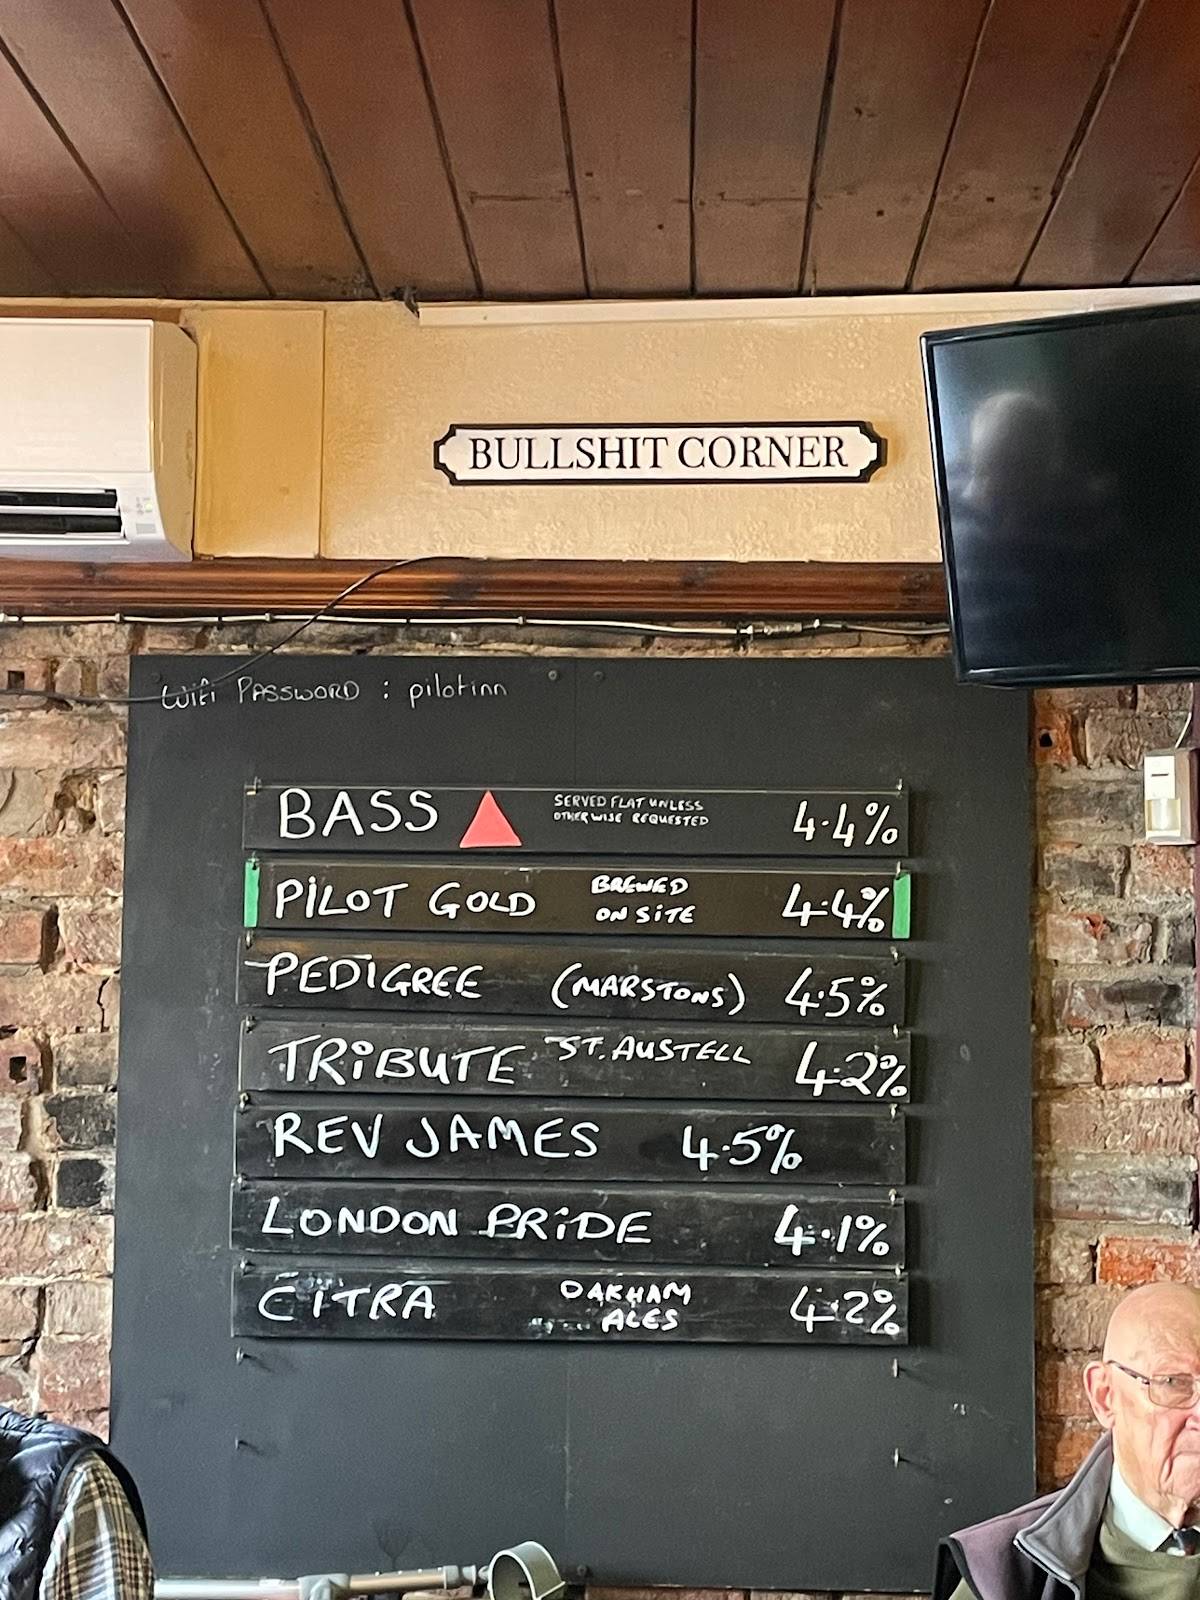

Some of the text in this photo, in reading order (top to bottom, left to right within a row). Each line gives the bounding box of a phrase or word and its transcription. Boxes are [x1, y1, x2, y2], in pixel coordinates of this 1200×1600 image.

[469, 435, 848, 469] BULLSHIT CORNER
[409, 673, 508, 709] pilotinn
[279, 788, 439, 838] BASS
[554, 794, 704, 811] SERVED FLAT UNLESS
[632, 813, 710, 827] REQUESTED
[428, 882, 537, 919] GOLD
[590, 875, 689, 896] BREWED
[595, 906, 628, 924] ON
[245, 951, 484, 997] PEDIGREE
[272, 1112, 383, 1159] REV
[406, 1115, 600, 1159] JAMES
[260, 1196, 457, 1237] LONDON
[559, 1280, 693, 1305] OAKHAM
[601, 1308, 681, 1333] ALES
